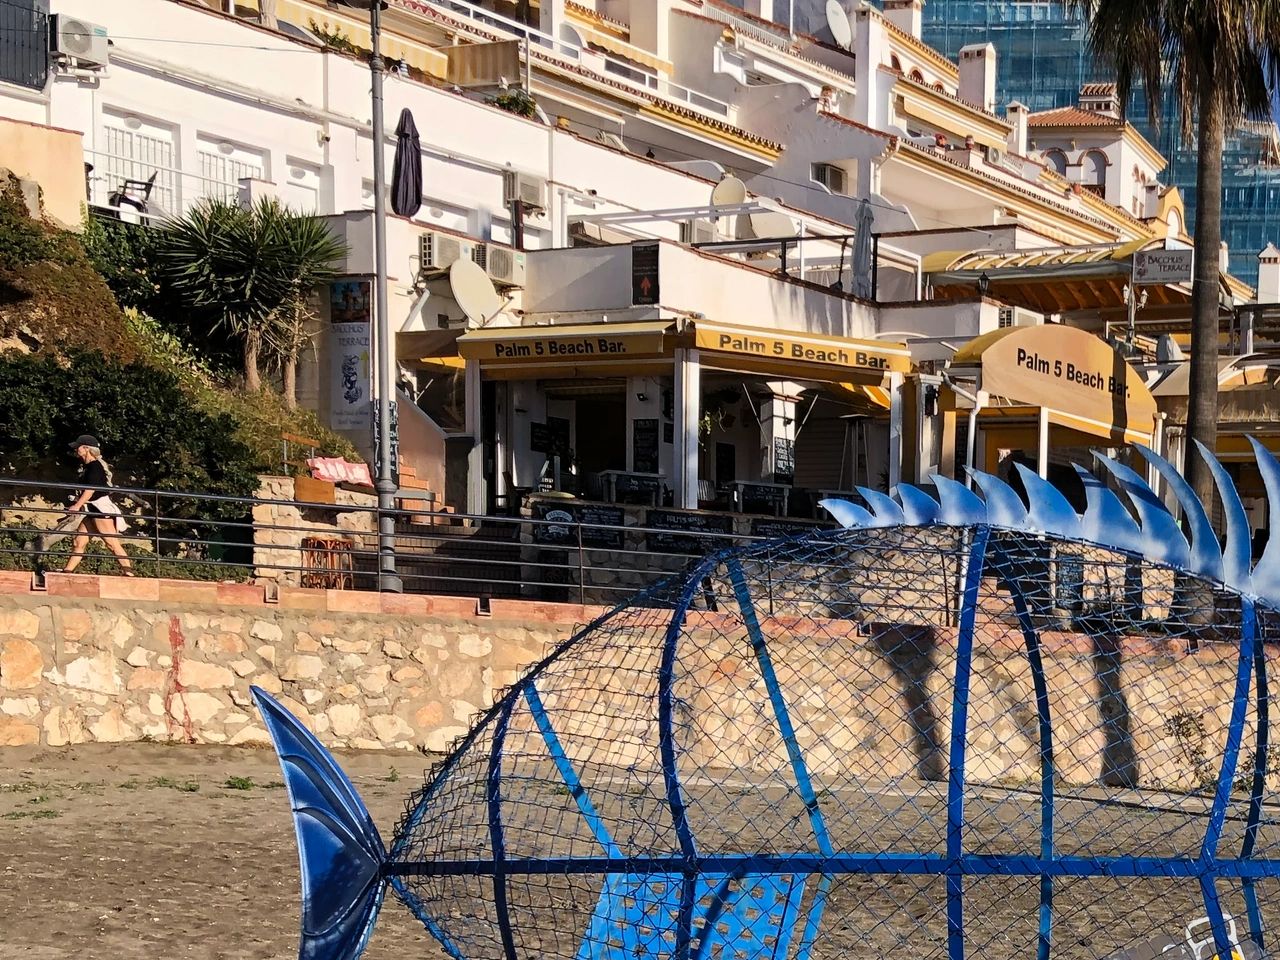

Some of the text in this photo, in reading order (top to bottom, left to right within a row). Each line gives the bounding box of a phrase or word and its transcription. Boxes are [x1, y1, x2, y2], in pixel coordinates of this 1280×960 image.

[1158, 264, 1191, 272] TERRACE
[495, 339, 626, 358] Palm 5 Beach Bar.
[719, 334, 890, 368] Palm 5 Beach Bar.
[1017, 348, 1131, 398] Palm 5 Beach Bar.
